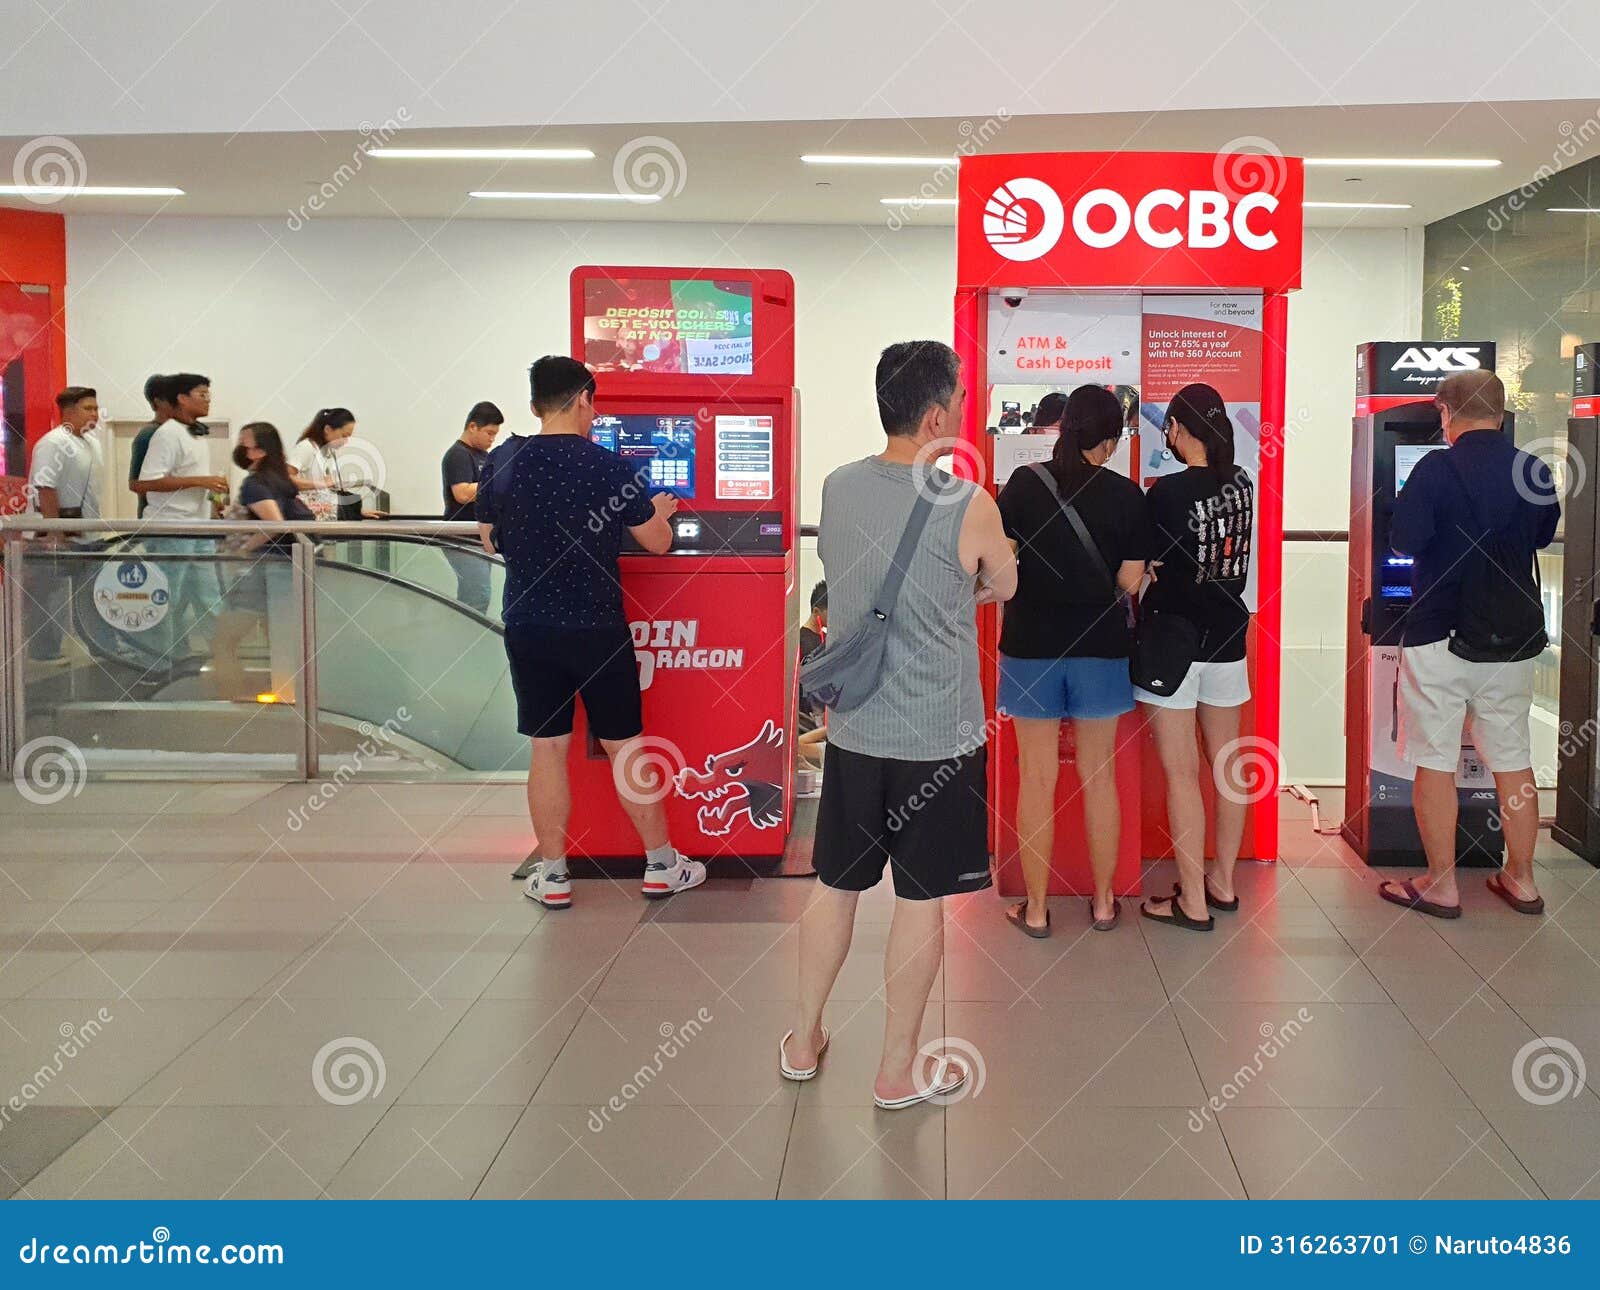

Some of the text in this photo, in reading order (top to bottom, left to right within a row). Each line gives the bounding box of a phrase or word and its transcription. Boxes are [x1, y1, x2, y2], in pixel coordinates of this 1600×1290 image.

[1072, 188, 1280, 250] OCBC
[606, 307, 673, 318] DEPOSIT
[677, 309, 724, 319] COIS
[598, 319, 736, 331] GET E-VOUCHERS
[627, 331, 647, 339] AT
[648, 331, 672, 340] NO
[1148, 330, 1227, 339] Unlock interest of
[1017, 336, 1067, 349] ATM &
[1174, 340, 1200, 348] 7.65%
[1148, 350, 1242, 358] with the 360 Account
[1390, 347, 1481, 371] AXS
[1016, 356, 1113, 373] Cash Deposit
[628, 620, 698, 648] OIN
[1381, 653, 1399, 661] Pay
